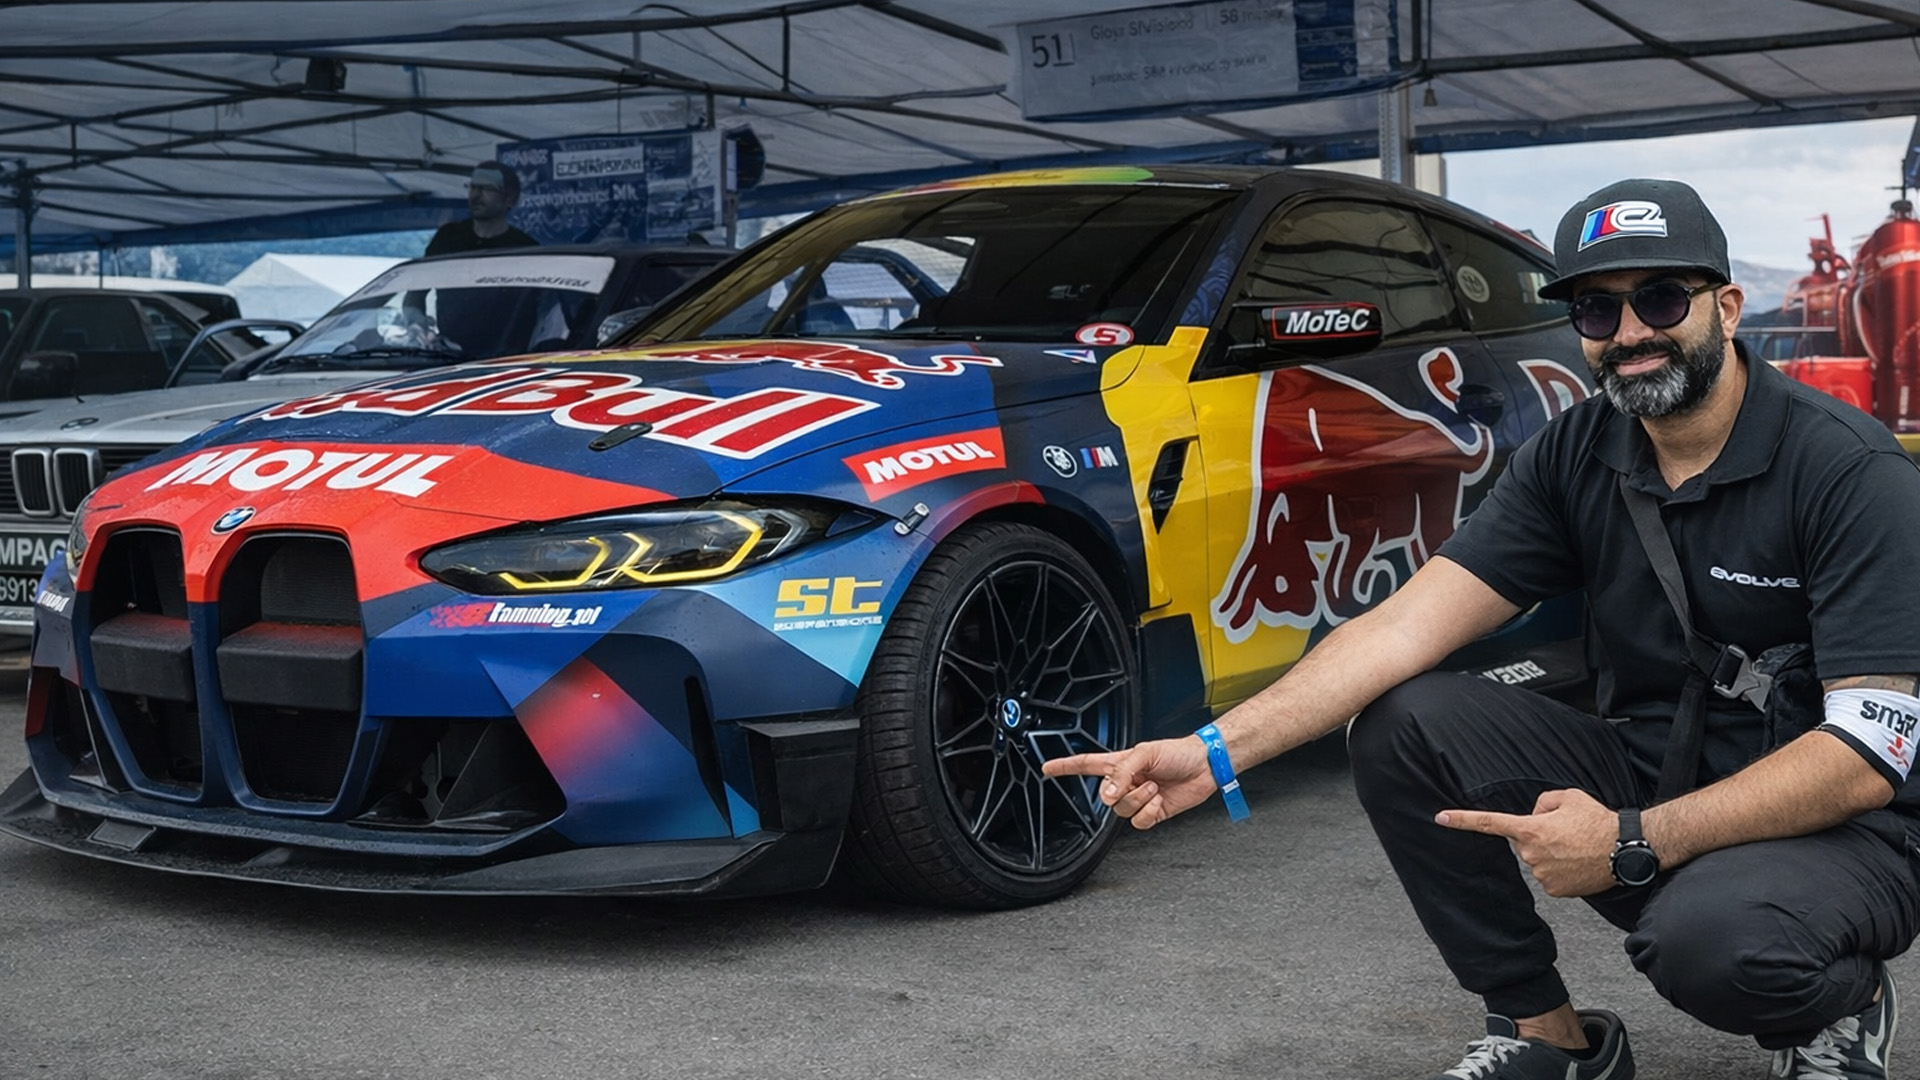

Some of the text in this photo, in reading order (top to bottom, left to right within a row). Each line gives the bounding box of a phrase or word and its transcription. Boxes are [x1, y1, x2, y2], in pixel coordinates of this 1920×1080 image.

[1284, 308, 1370, 334] MoTeC
[428, 371, 881, 460] Bull
[144, 447, 456, 498] MOTUL
[863, 440, 996, 484] MOTUL
